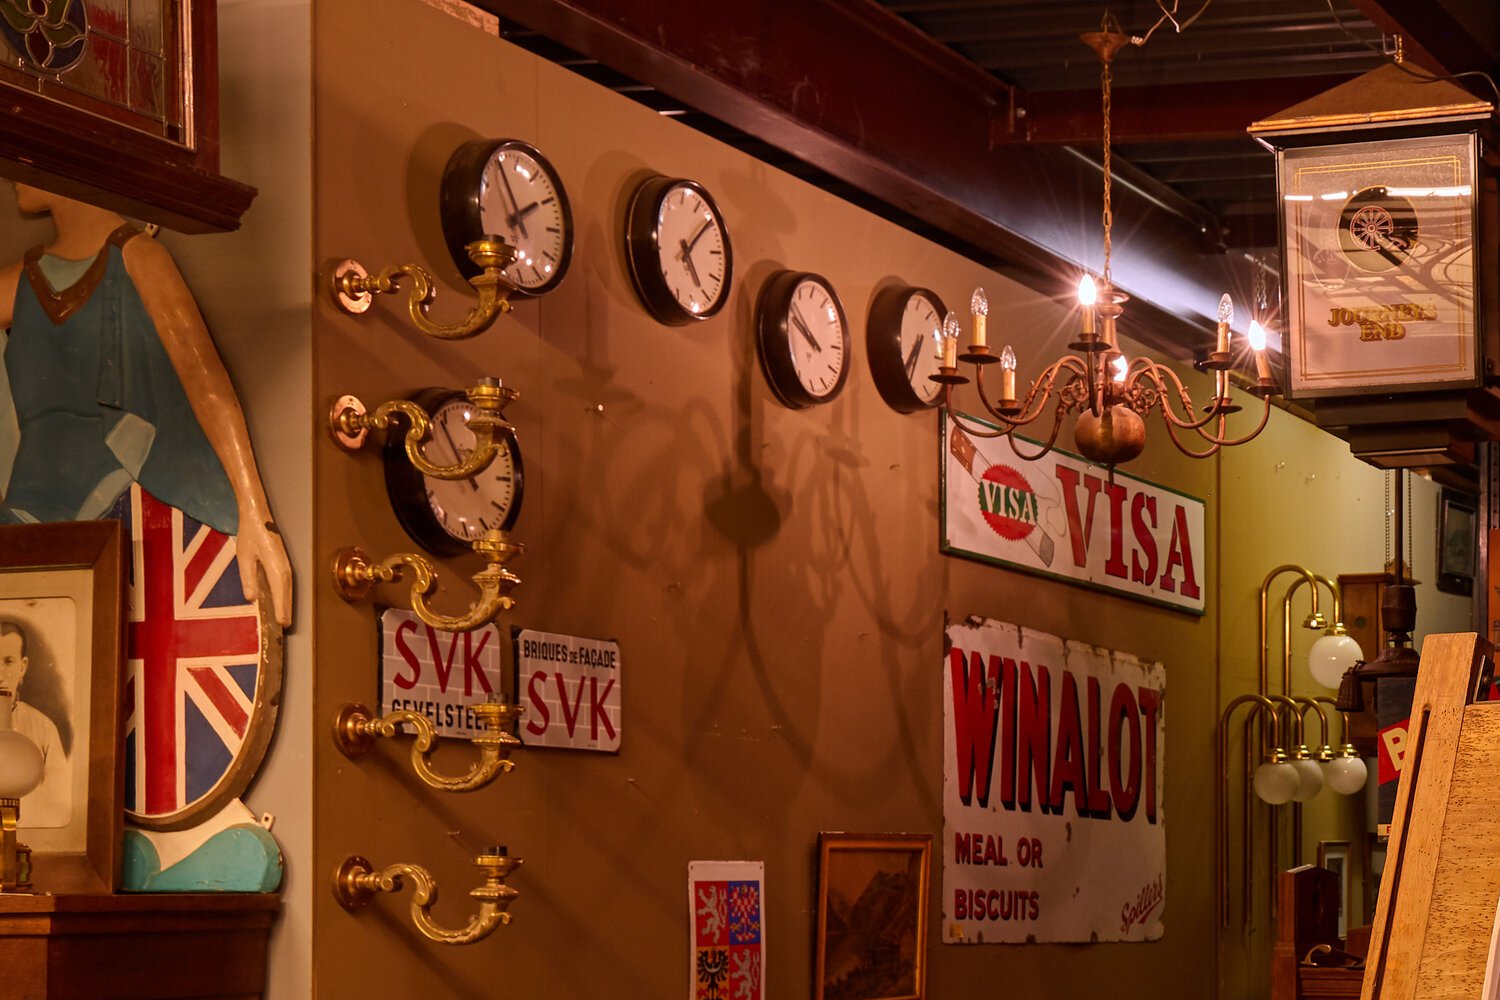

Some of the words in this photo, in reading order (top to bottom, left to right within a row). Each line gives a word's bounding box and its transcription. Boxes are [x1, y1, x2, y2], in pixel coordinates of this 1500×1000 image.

[1359, 322, 1406, 343] END
[980, 478, 1037, 525] VISA
[1055, 463, 1201, 601] VISA
[392, 619, 494, 697] SVK
[523, 639, 568, 663] BRIQUES
[579, 647, 616, 669] FAÇADE
[526, 670, 617, 741] SVK
[950, 646, 1161, 825] WINALOT
[954, 832, 1007, 866] MEAL
[1016, 836, 1044, 868] OR
[954, 888, 1040, 921] BISCUITS
